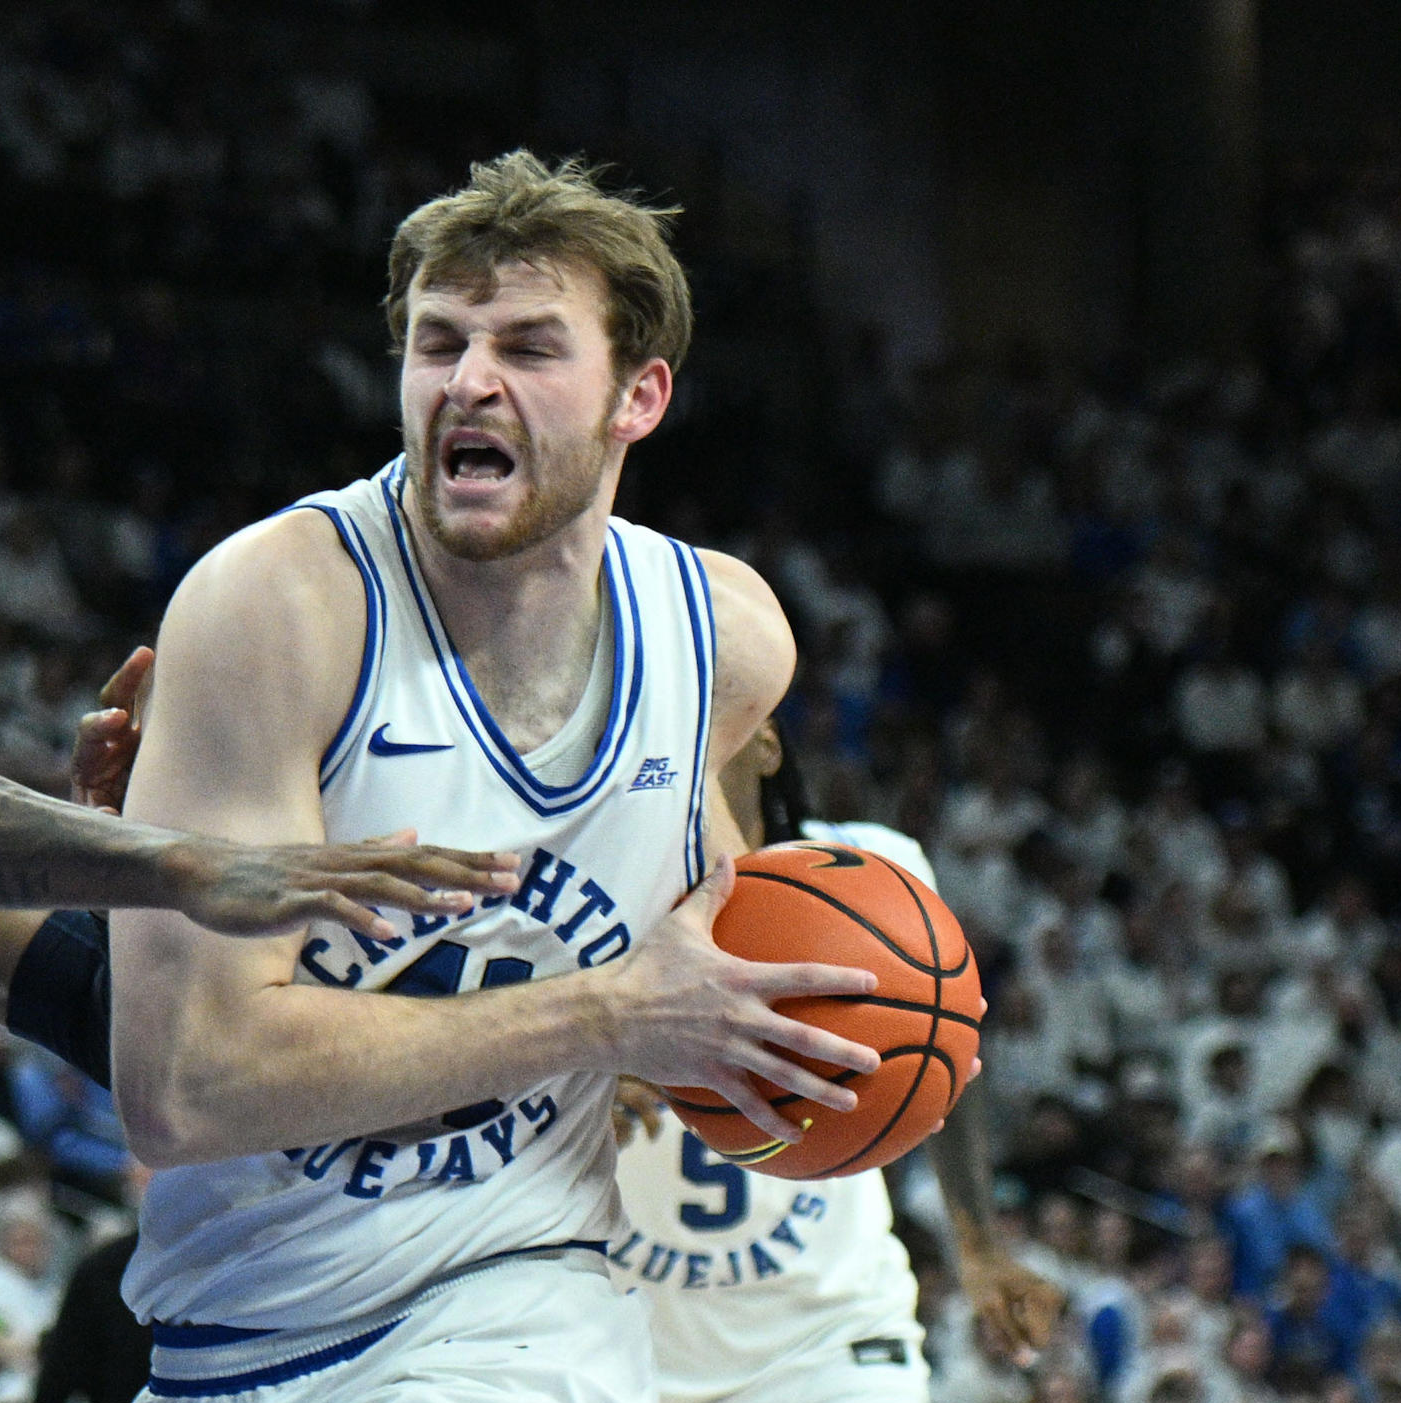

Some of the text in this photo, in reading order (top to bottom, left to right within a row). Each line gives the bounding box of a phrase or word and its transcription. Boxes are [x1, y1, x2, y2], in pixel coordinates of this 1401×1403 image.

[639, 757, 671, 772] BIG
[631, 771, 679, 787] EAST
[680, 1130, 749, 1232] 5
